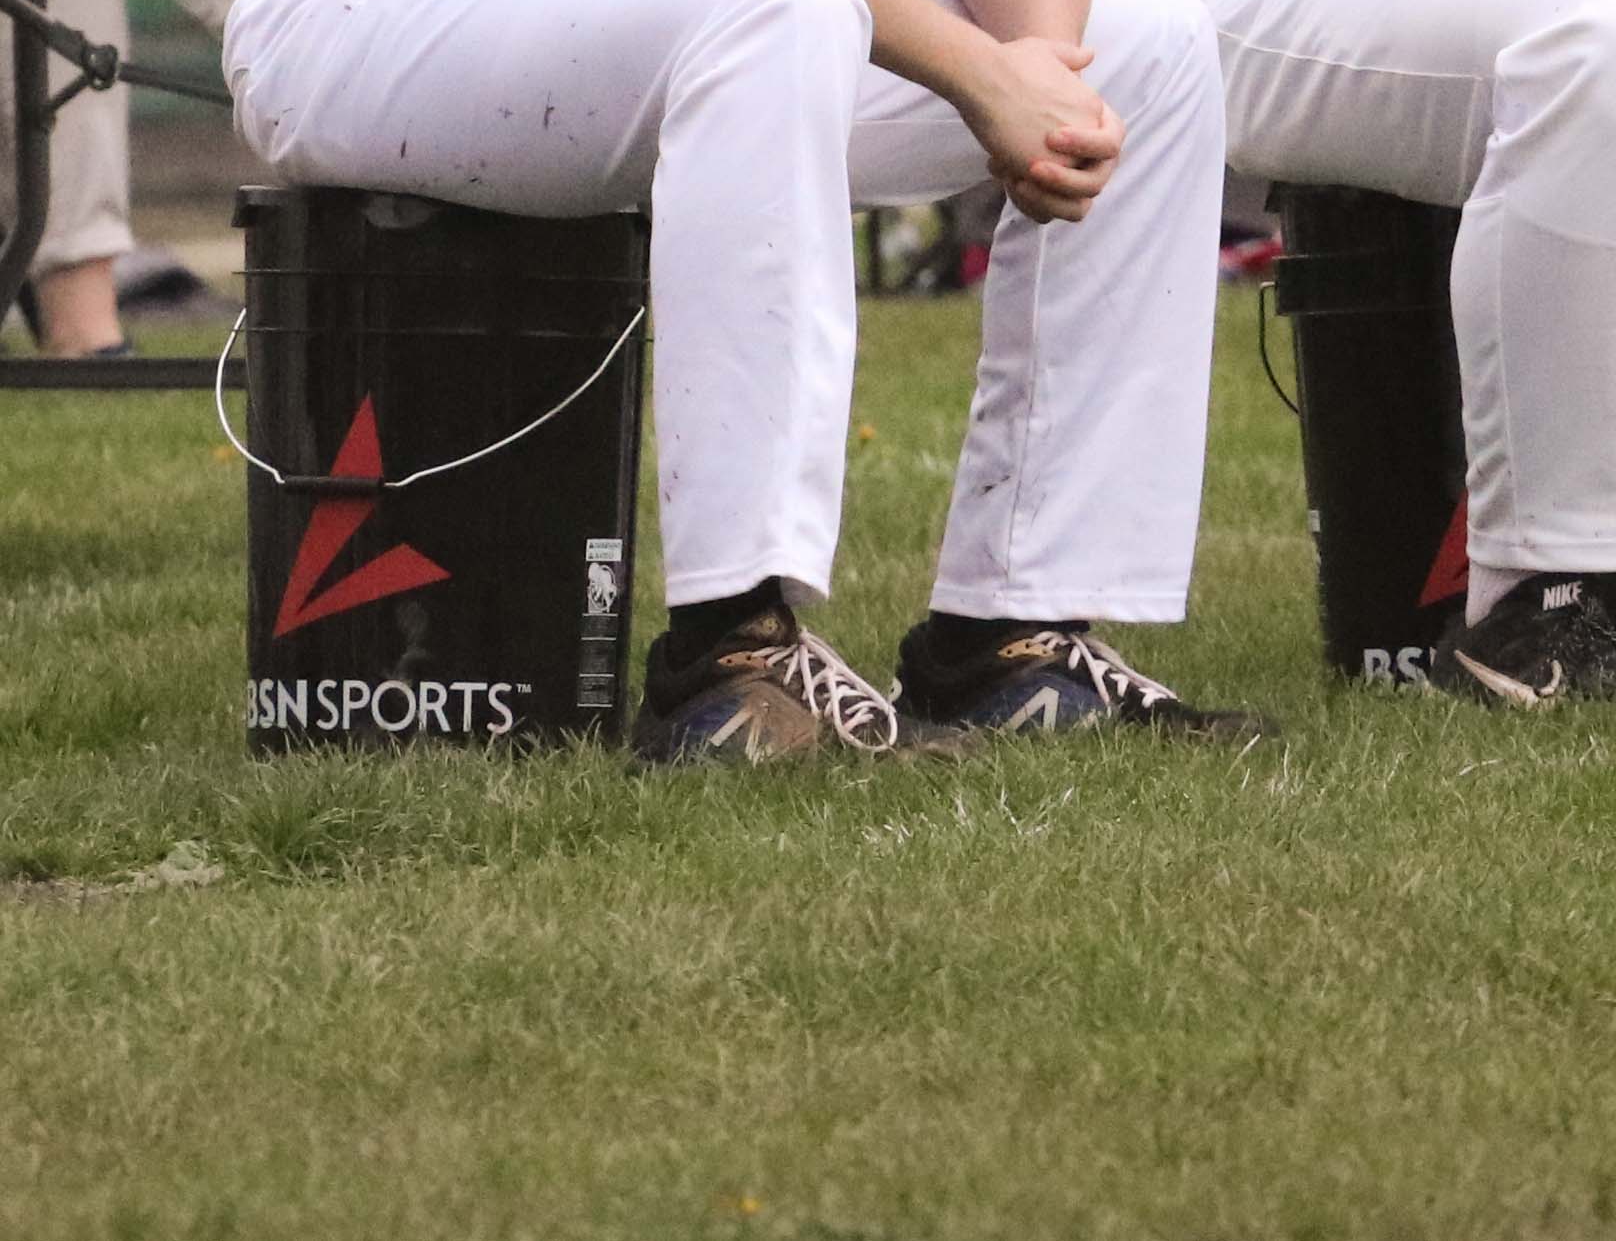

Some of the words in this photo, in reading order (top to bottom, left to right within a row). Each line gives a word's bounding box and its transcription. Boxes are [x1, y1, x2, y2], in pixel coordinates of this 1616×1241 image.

[1542, 580, 1582, 611] NIKE
[1362, 645, 1437, 687] BS
[246, 678, 308, 729] BSN
